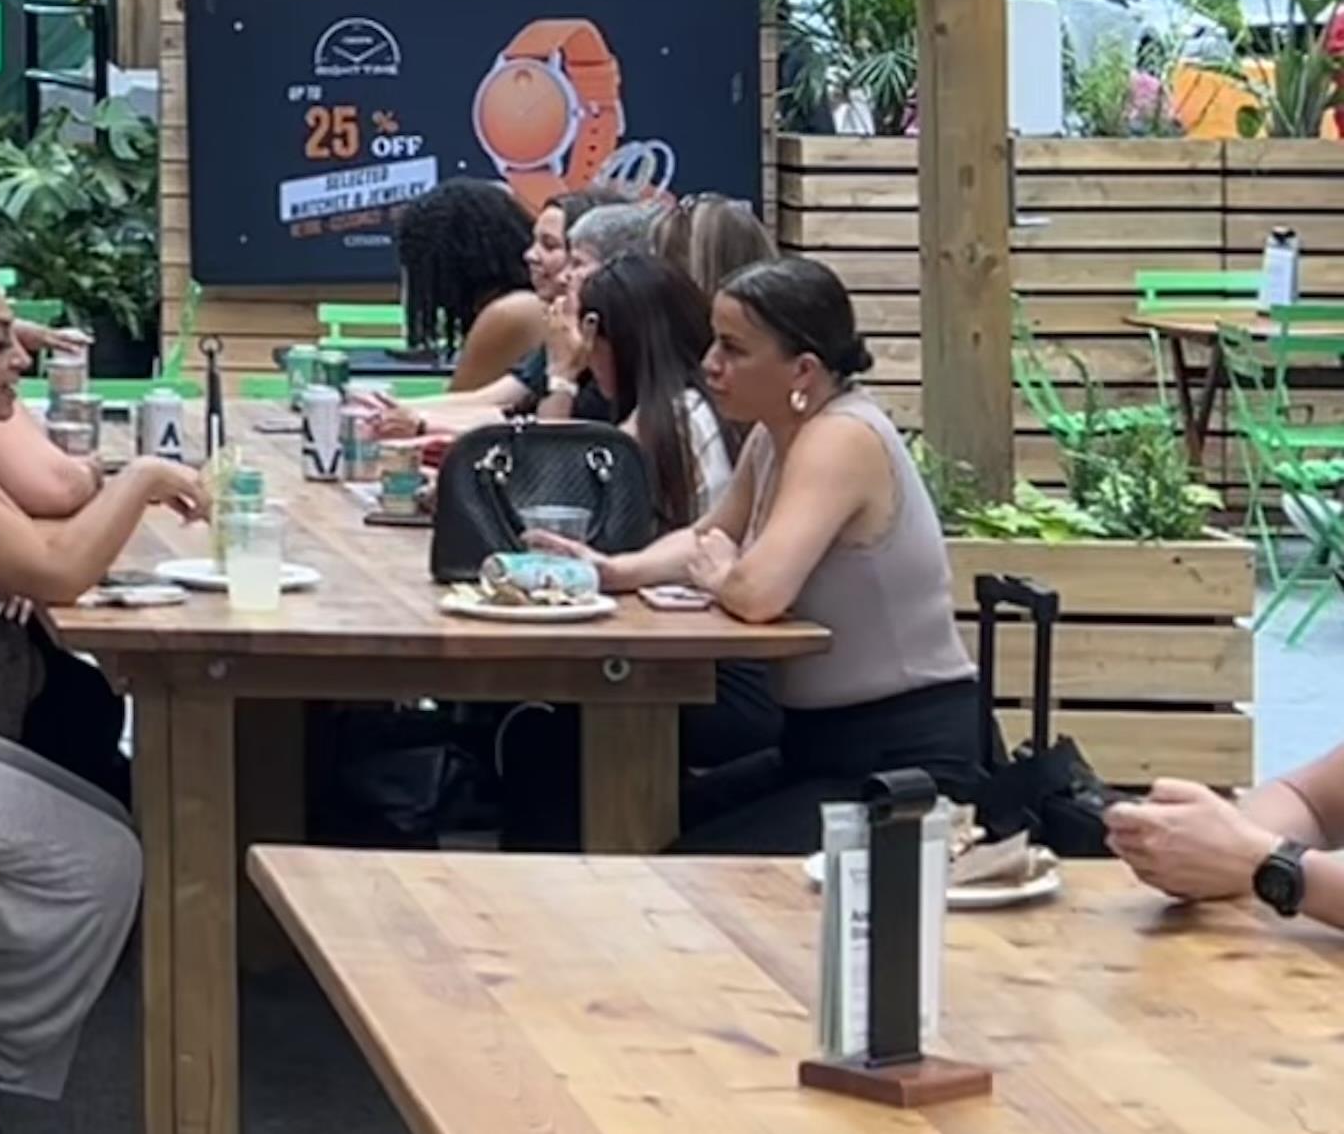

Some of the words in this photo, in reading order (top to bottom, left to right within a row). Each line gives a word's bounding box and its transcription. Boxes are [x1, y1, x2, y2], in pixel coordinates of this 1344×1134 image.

[305, 106, 361, 158] 25
[372, 111, 399, 133] %
[371, 136, 423, 157] OFF
